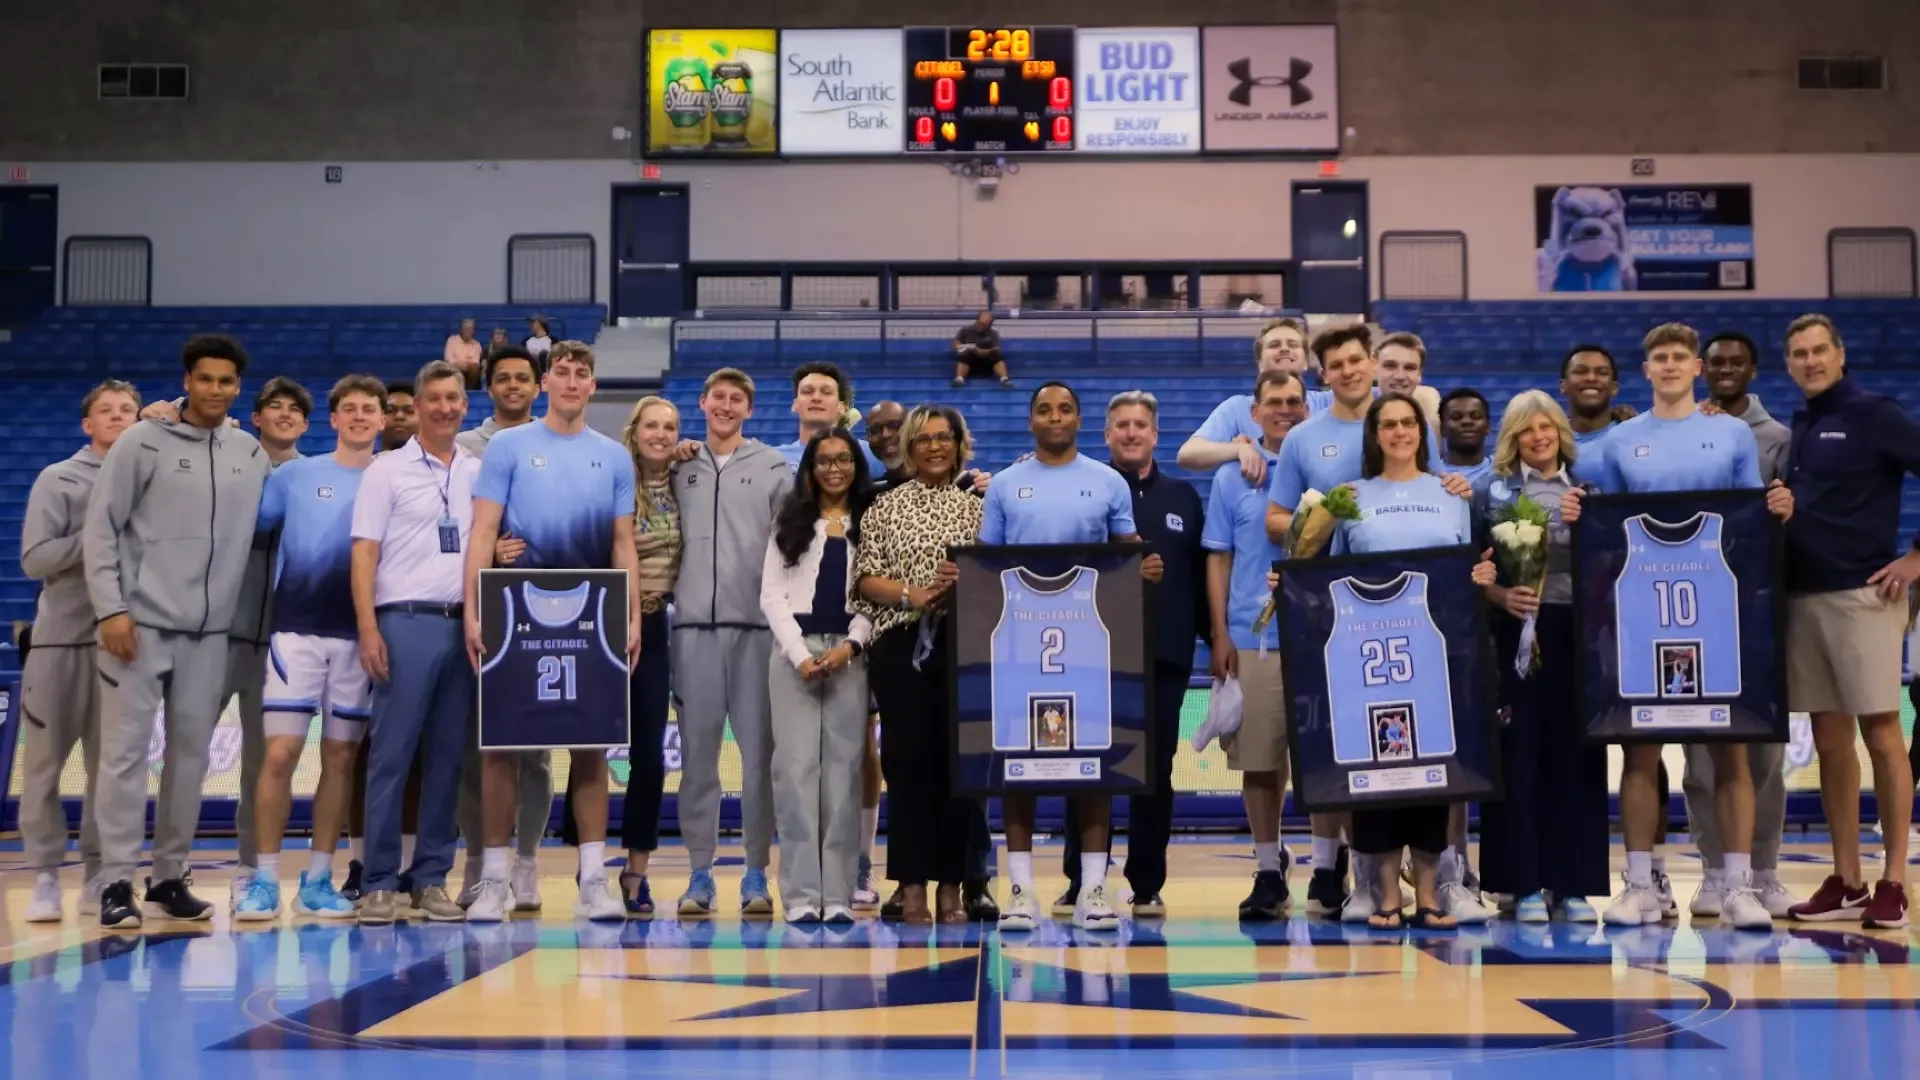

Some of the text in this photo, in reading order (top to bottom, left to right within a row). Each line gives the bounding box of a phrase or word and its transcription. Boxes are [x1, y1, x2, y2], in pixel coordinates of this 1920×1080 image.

[968, 29, 1030, 61] 2:28
[1100, 41, 1174, 70] BUD
[787, 53, 852, 76] South
[915, 61, 965, 78] CITADEL
[812, 80, 896, 102] Atlantic
[935, 78, 956, 110] 0
[989, 81, 999, 105] 1
[1050, 77, 1071, 108] 0
[1086, 73, 1189, 102] LIGHT
[848, 111, 890, 130] Bank
[1114, 117, 1161, 131] ENJOY
[1214, 112, 1328, 121] UNDER ARMOUR
[916, 116, 934, 143] 0
[1053, 116, 1072, 142] 0
[1086, 132, 1189, 147] RESPONSIBLY
[329, 168, 341, 180] 18
[1629, 229, 1714, 241] GET YOUR
[1375, 504, 1441, 516] BASKETBALL
[1638, 562, 1711, 572] THE CITADEL
[1654, 579, 1698, 627] 10
[1013, 610, 1088, 620] THE CITADEL
[1346, 618, 1420, 632] THE CITADEL
[521, 639, 589, 650] THE CITADEL
[1041, 627, 1065, 674] 2
[1360, 636, 1414, 687] 25
[537, 655, 577, 700] 21
